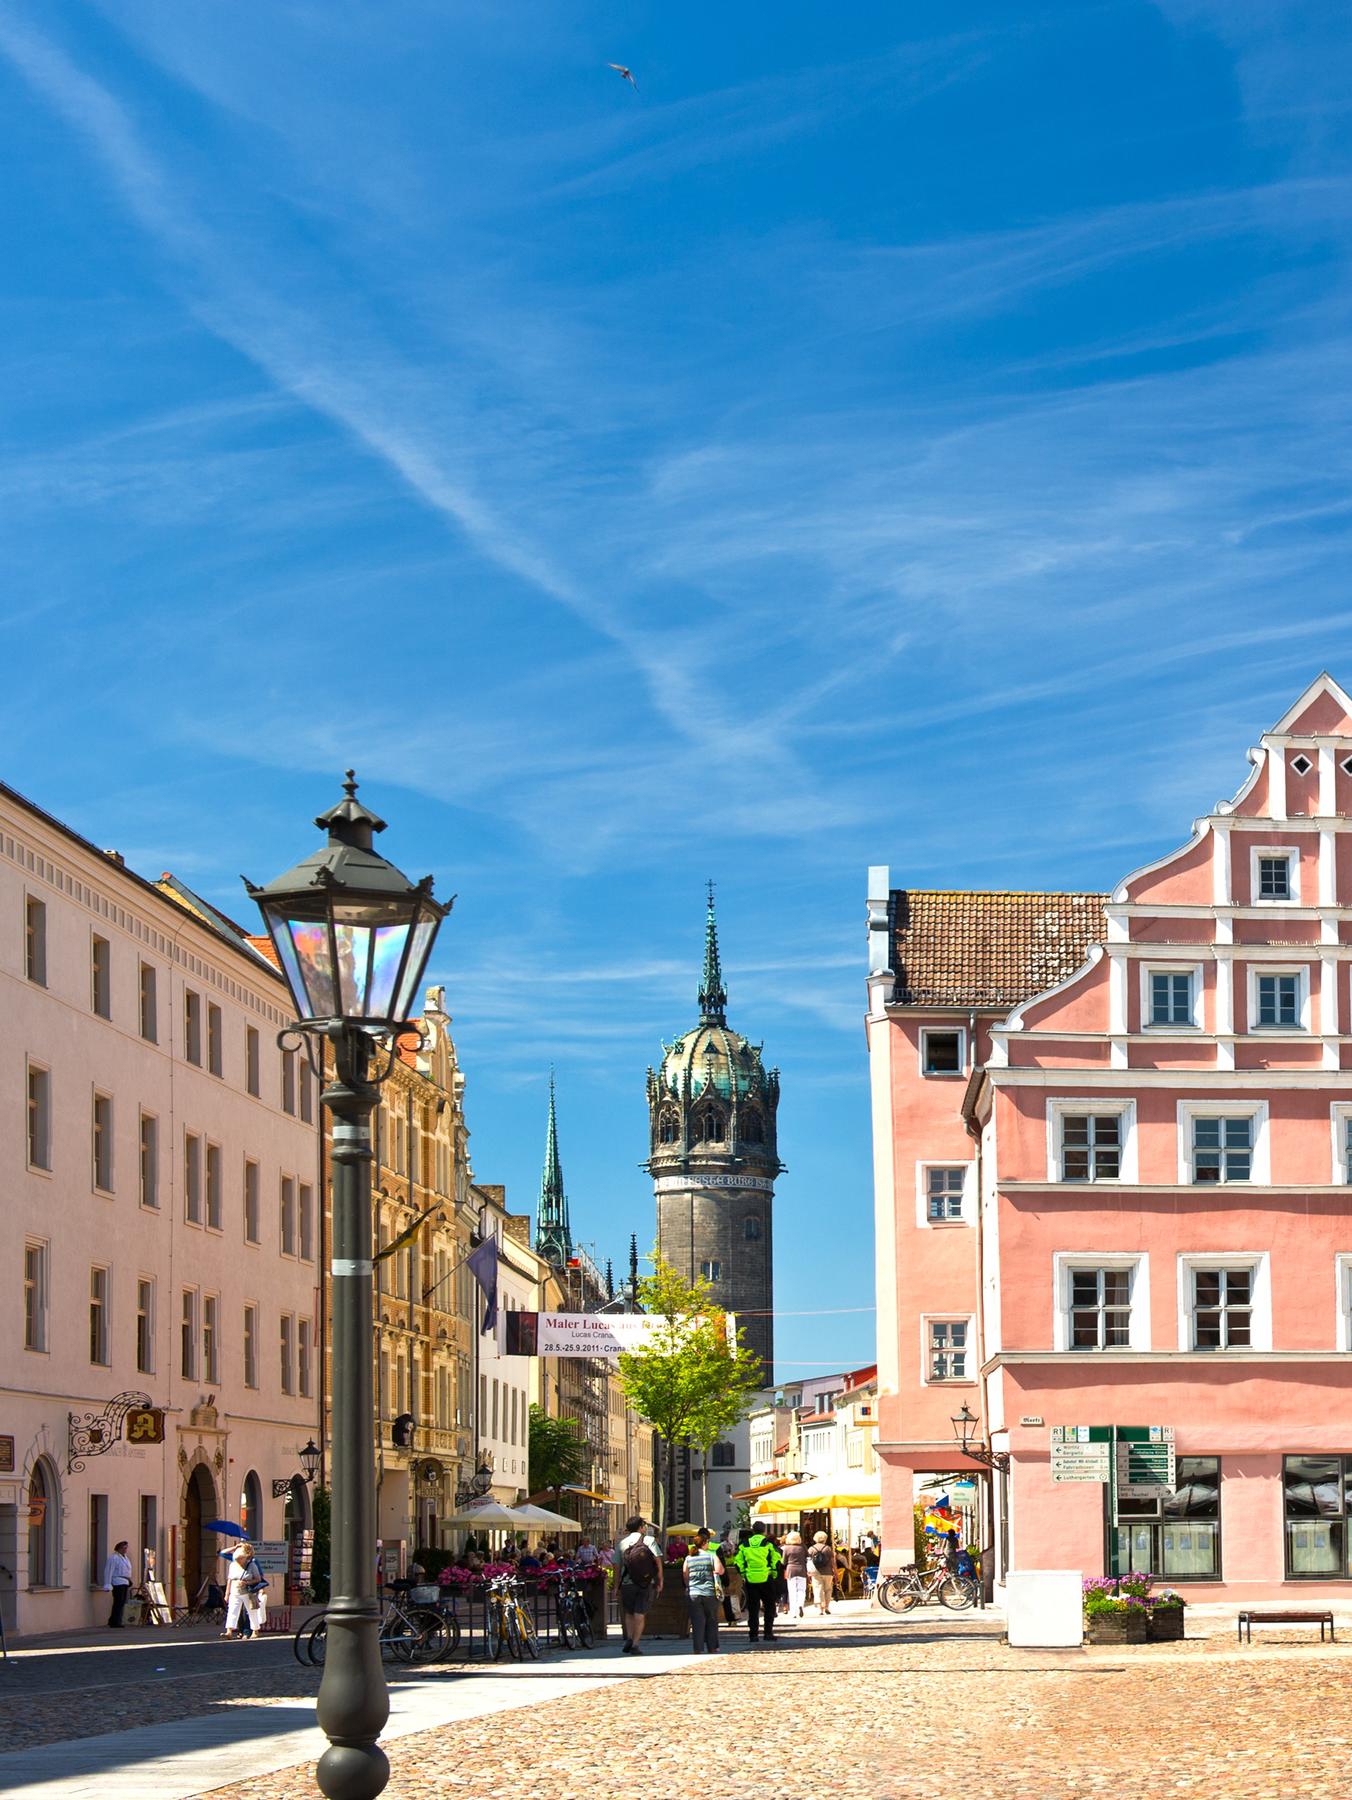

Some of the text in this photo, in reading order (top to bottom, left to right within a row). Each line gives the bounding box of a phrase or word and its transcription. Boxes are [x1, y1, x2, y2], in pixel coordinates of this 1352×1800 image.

[727, 1175, 753, 1186] BURG
[545, 1318, 579, 1329] Maler
[583, 1319, 616, 1330] Lucas
[420, 1487, 440, 1497] HOTEL
